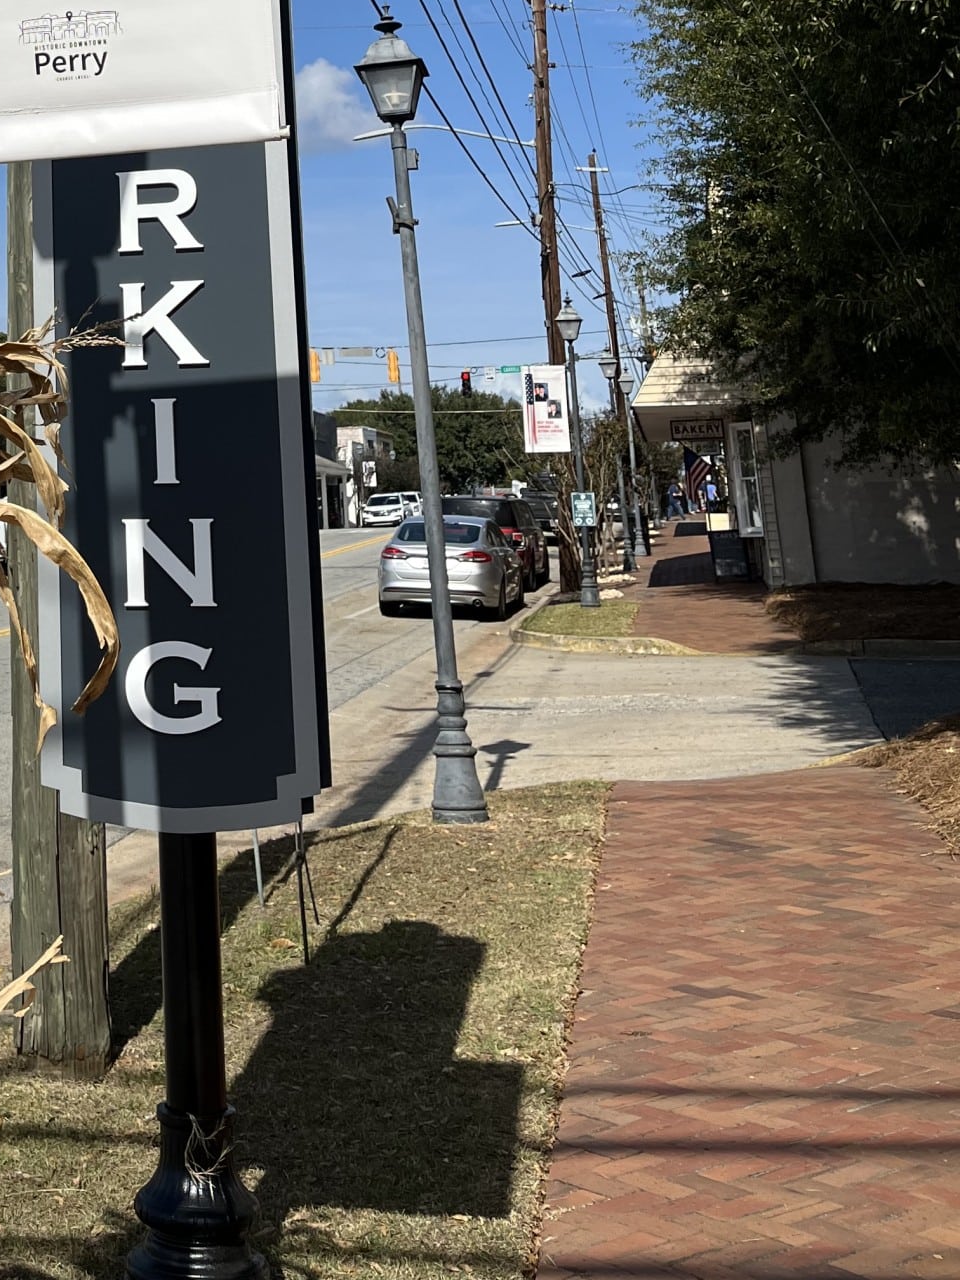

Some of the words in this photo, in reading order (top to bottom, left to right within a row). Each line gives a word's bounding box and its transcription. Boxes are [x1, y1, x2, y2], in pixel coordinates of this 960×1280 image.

[34, 42, 66, 51] HISTORIC
[69, 39, 107, 48] DOWNTOWN
[34, 51, 108, 76] Perry
[674, 422, 720, 434] BAKERY
[115, 168, 223, 735] RKING
